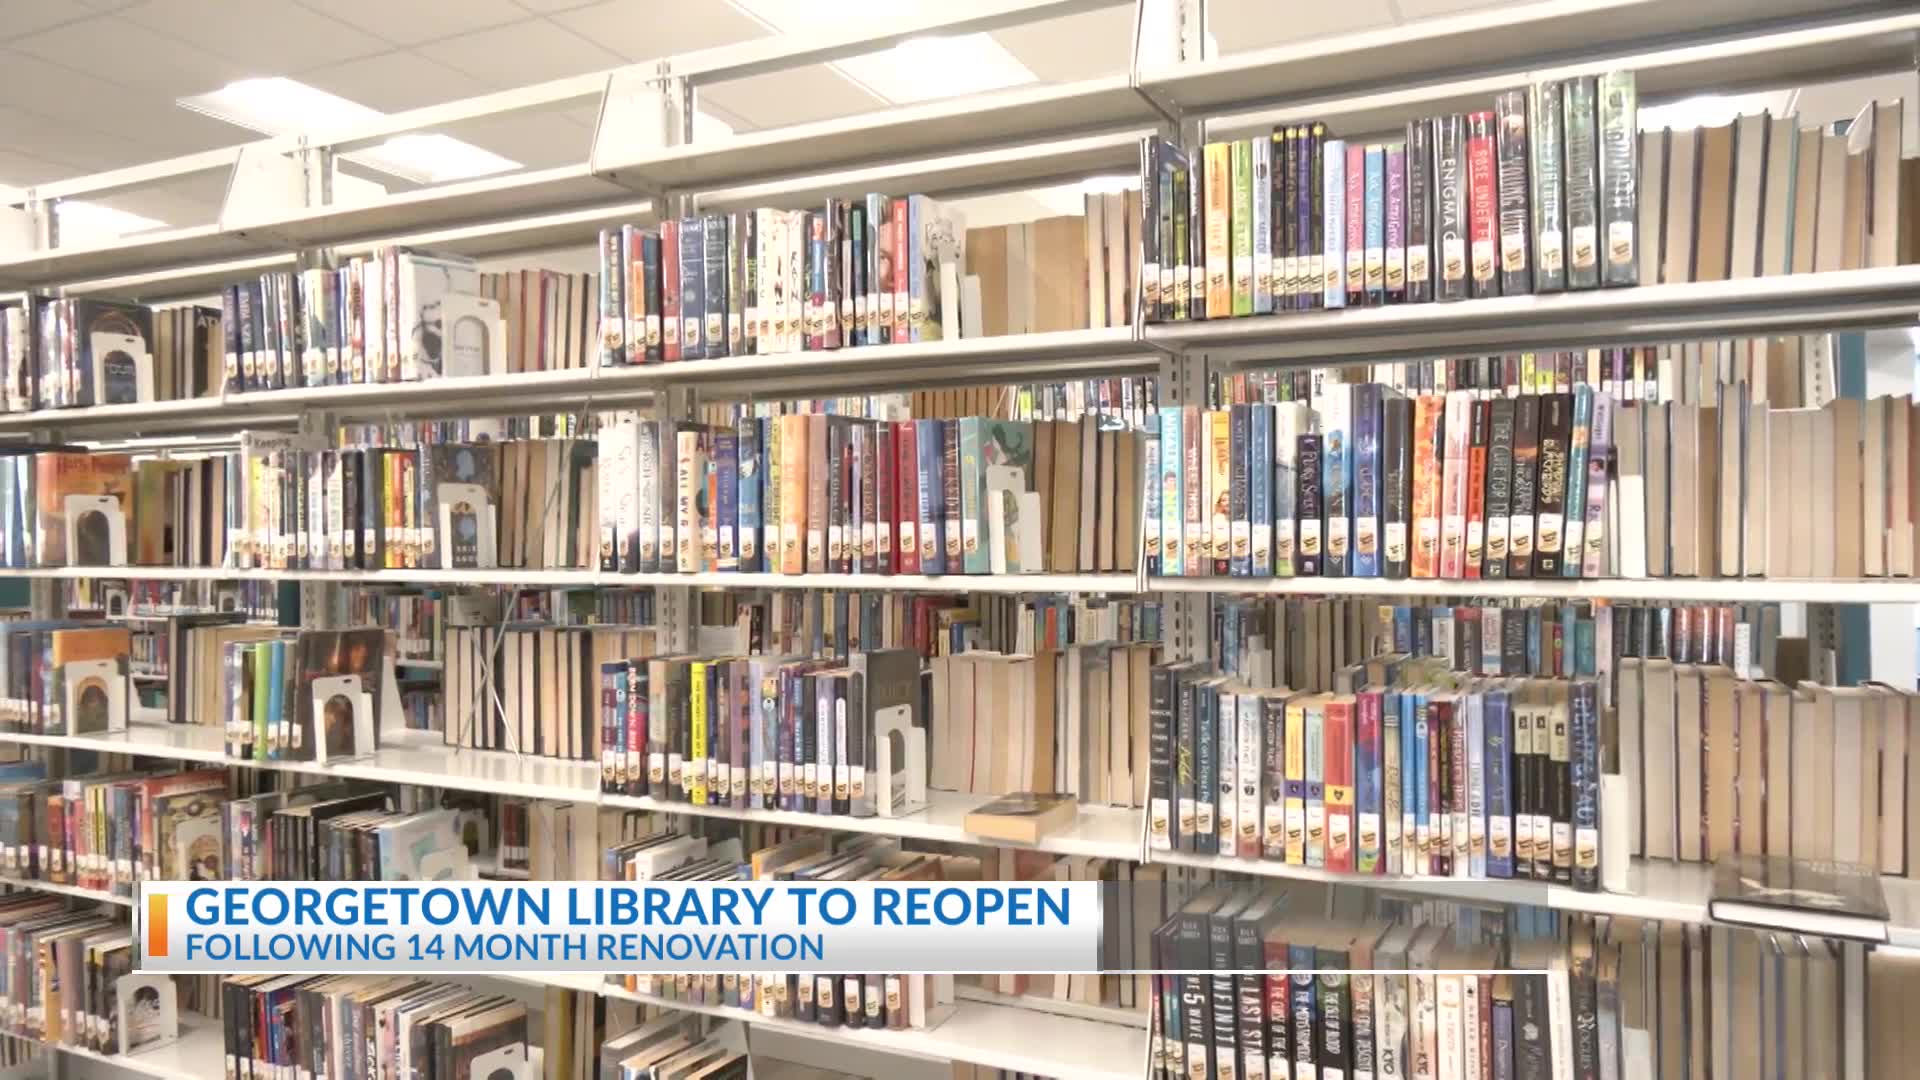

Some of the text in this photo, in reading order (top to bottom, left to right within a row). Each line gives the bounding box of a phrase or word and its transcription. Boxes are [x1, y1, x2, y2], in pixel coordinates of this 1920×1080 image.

[1475, 148, 1489, 181] ROSE
[1442, 158, 1457, 226] ENIGMA
[1475, 185, 1489, 224] UNDER
[1188, 1008, 1202, 1039] WAVE
[1240, 987, 1262, 1024] LAST
